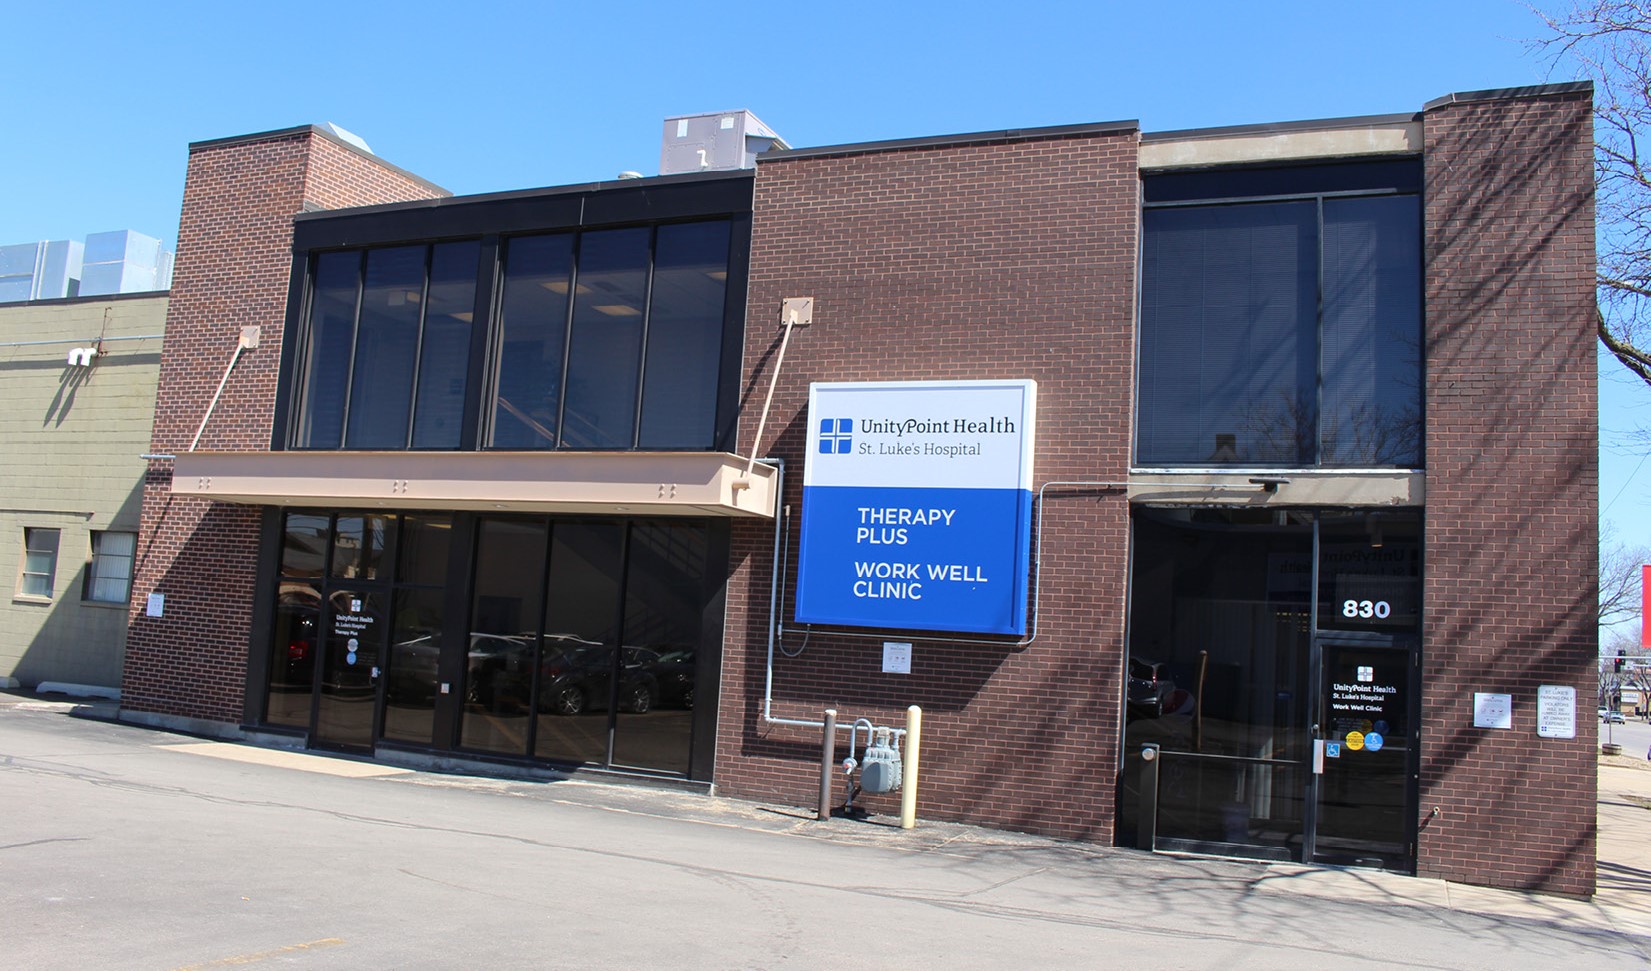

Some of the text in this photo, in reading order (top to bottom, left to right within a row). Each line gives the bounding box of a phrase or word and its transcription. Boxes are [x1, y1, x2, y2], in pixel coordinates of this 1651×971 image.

[861, 416, 1016, 437] UnityPoint Health
[858, 442, 981, 458] St. Luke's Hospital
[858, 507, 956, 526] THERAPY
[856, 527, 908, 545] PLUS
[854, 561, 988, 582] WORK WELL
[853, 580, 922, 600] CLINIC
[1342, 599, 1391, 618] 830
[1333, 683, 1397, 693] UnityPoint Health
[1360, 694, 1385, 702] Hospital
